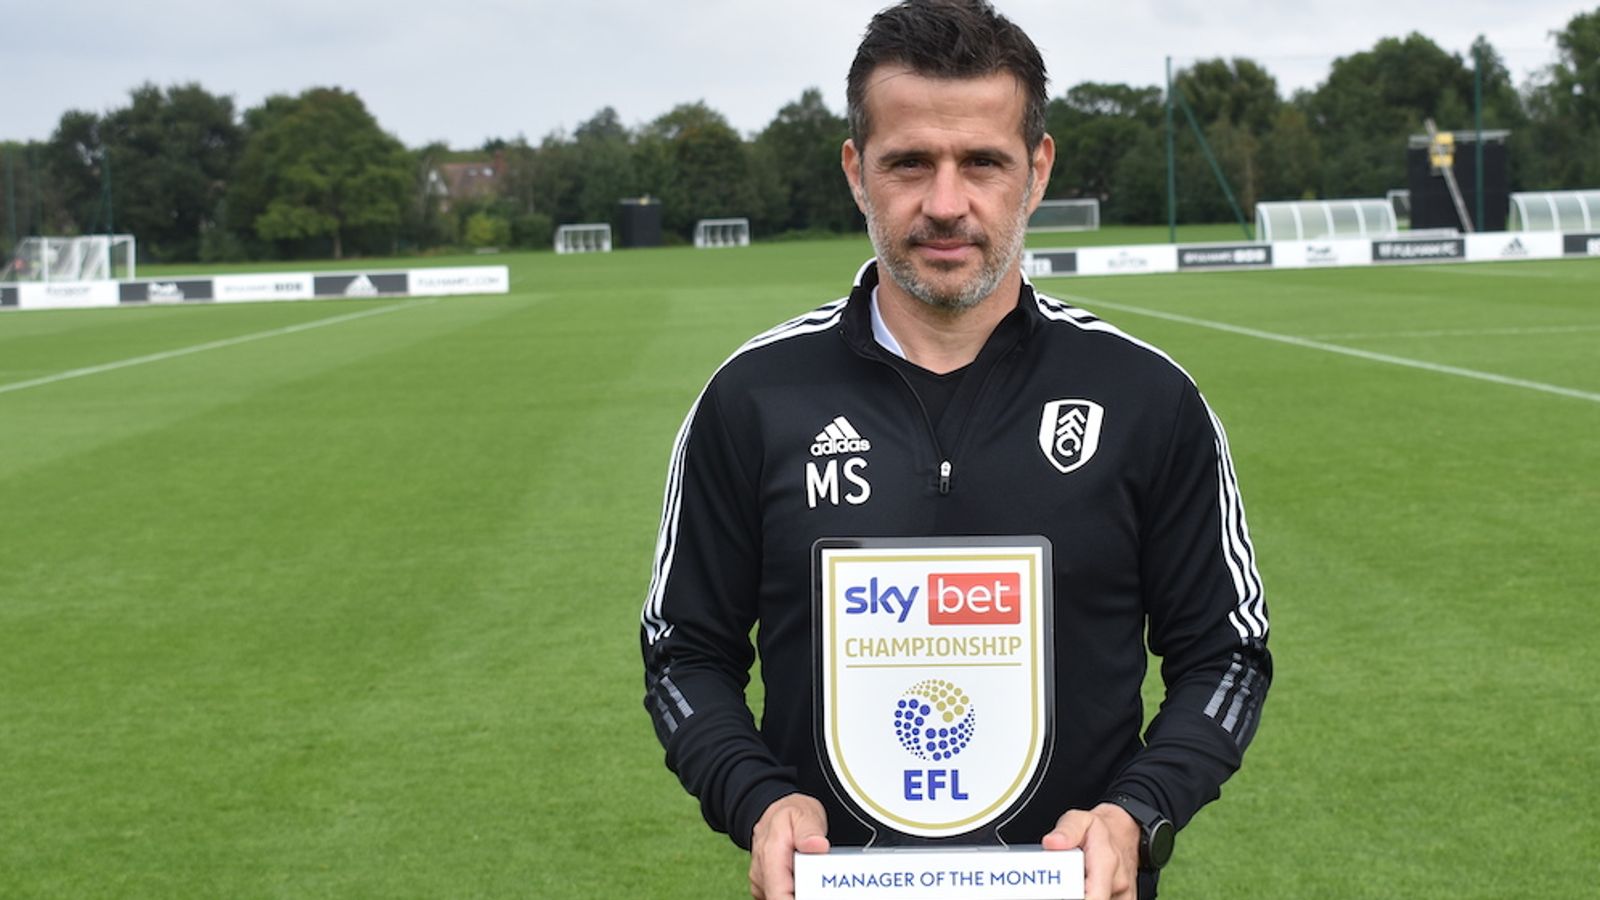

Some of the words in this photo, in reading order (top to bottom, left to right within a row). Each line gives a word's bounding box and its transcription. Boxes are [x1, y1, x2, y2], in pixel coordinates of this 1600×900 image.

[810, 439, 871, 456] adidas
[805, 457, 871, 508] MS
[844, 577, 919, 623] sky
[937, 577, 1012, 613] bet
[845, 636, 1022, 657] CHAMPIONSHIP
[903, 769, 969, 801] EFL
[821, 871, 914, 888] MANAGER
[919, 870, 945, 887] OF
[949, 870, 984, 886] THE
[990, 869, 1062, 886] MONTH
